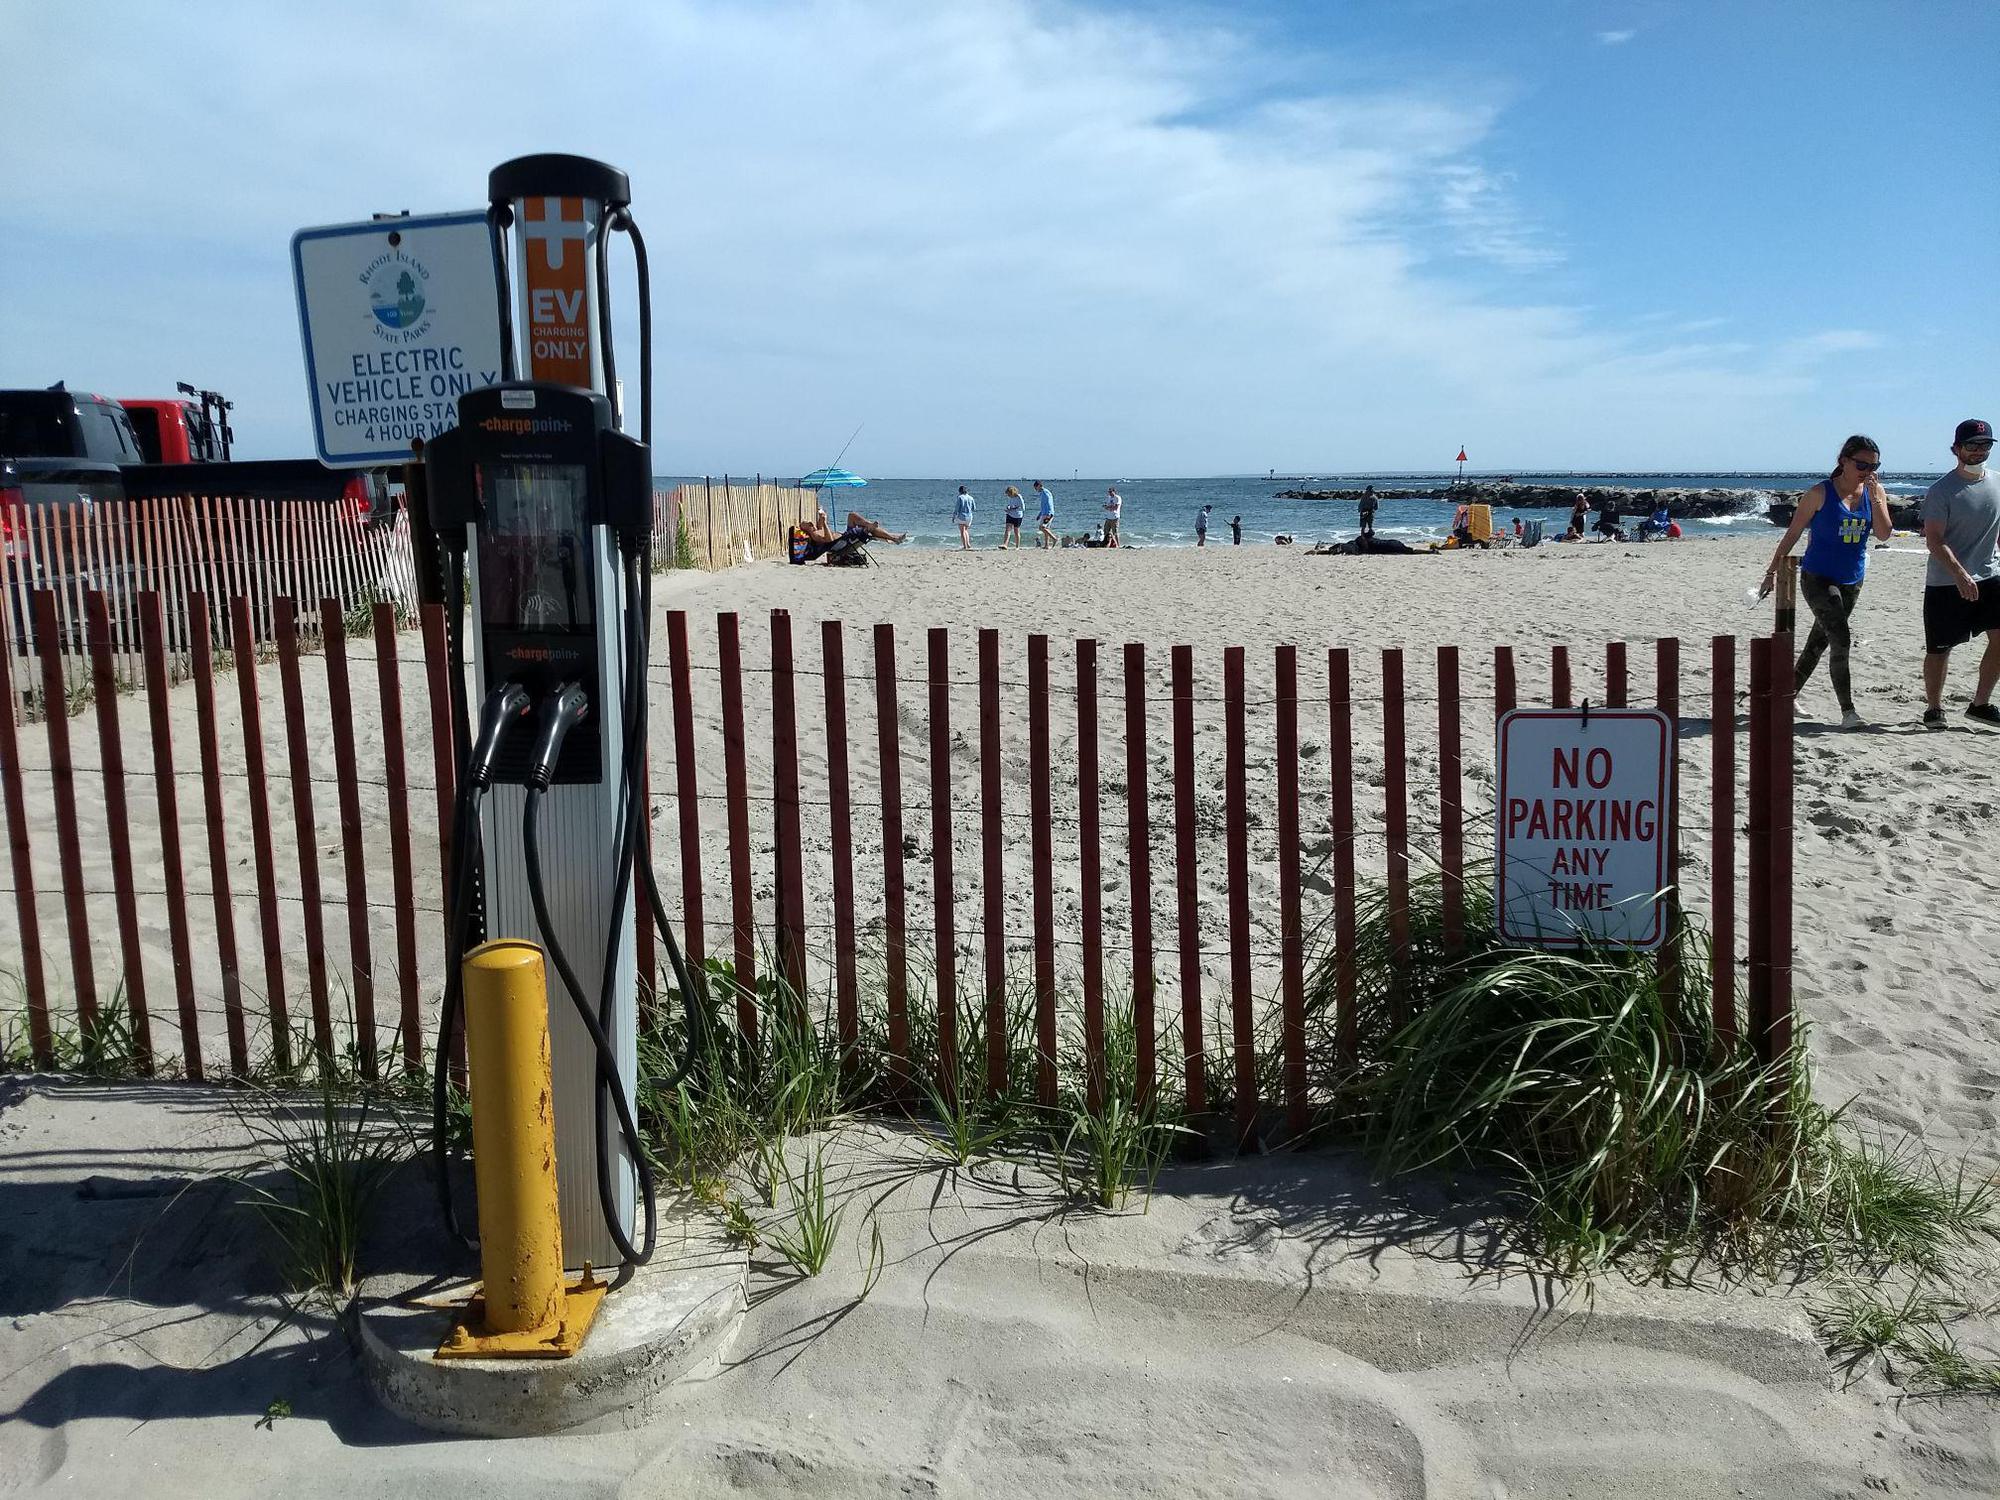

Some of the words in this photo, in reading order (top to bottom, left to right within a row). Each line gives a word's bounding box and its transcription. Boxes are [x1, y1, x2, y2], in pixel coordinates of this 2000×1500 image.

[360, 253, 391, 285] RHODE
[396, 249, 430, 280] ISLAND
[533, 288, 584, 323] EV
[373, 323, 398, 344] STATE
[403, 320, 431, 343] PARKS
[533, 327, 585, 337] CHARGING
[352, 347, 464, 377] ELECTRIC
[534, 340, 586, 359] ONLY
[327, 376, 424, 405] VEHICLE
[430, 371, 496, 397] ONLY
[334, 405, 419, 426] CHARGING
[365, 426, 375, 442] 4
[379, 423, 427, 441] HOUR
[1552, 747, 1612, 789] NO
[1508, 799, 1655, 842] PARKING
[1551, 847, 1611, 876] ANY
[1548, 882, 1613, 912] TIME
